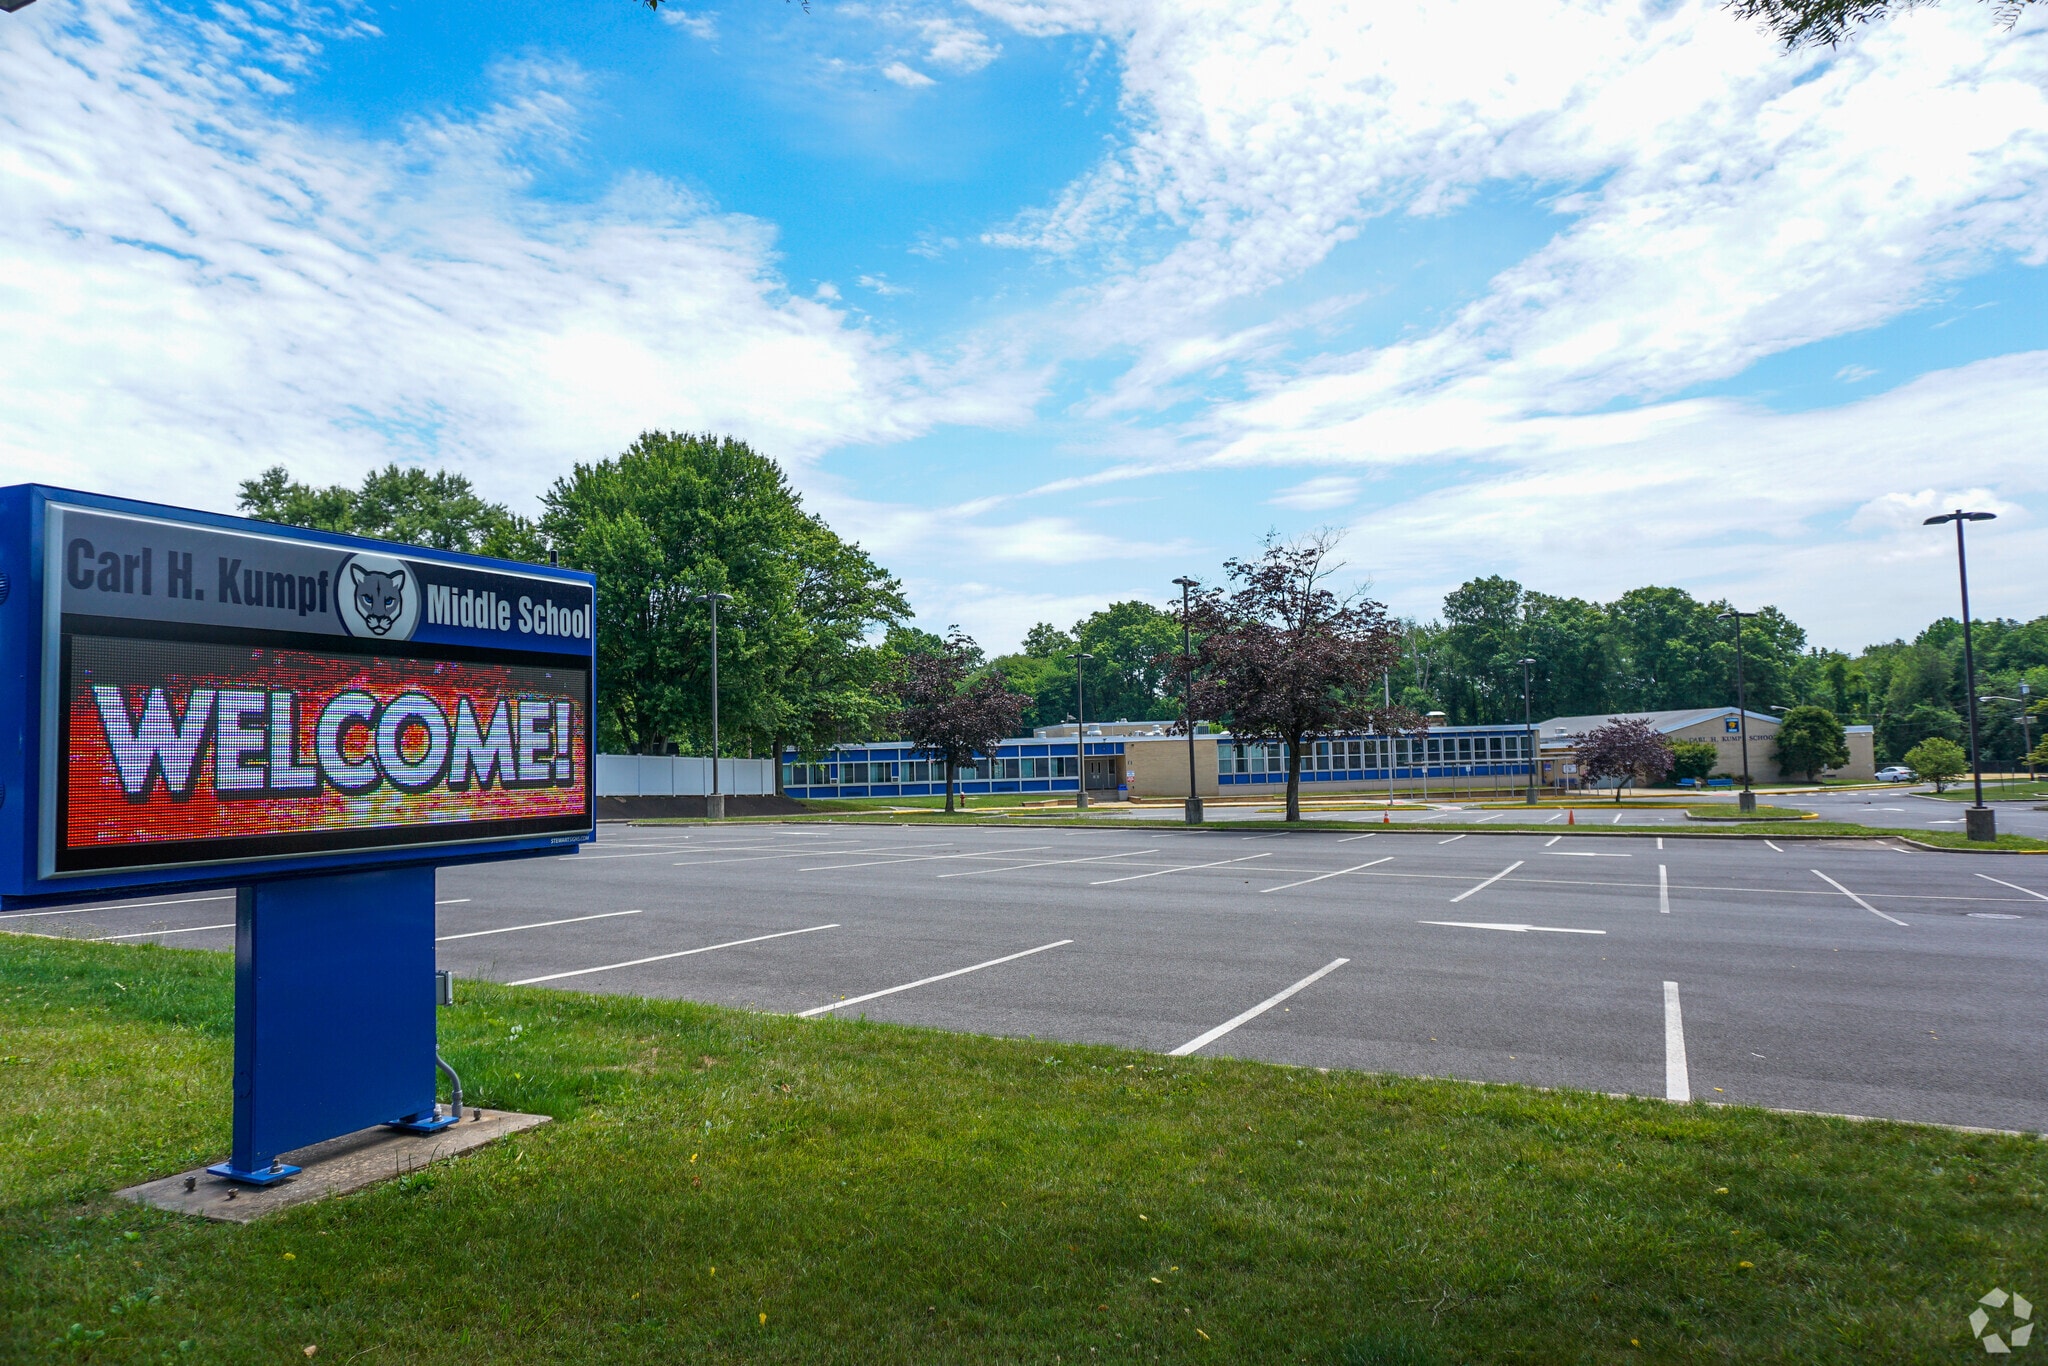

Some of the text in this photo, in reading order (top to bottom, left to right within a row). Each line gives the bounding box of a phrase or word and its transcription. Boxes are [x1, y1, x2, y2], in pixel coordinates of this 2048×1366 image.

[67, 538, 590, 639] Carl H. Kumpf Middle School
[92, 685, 574, 797] WELCOME!
